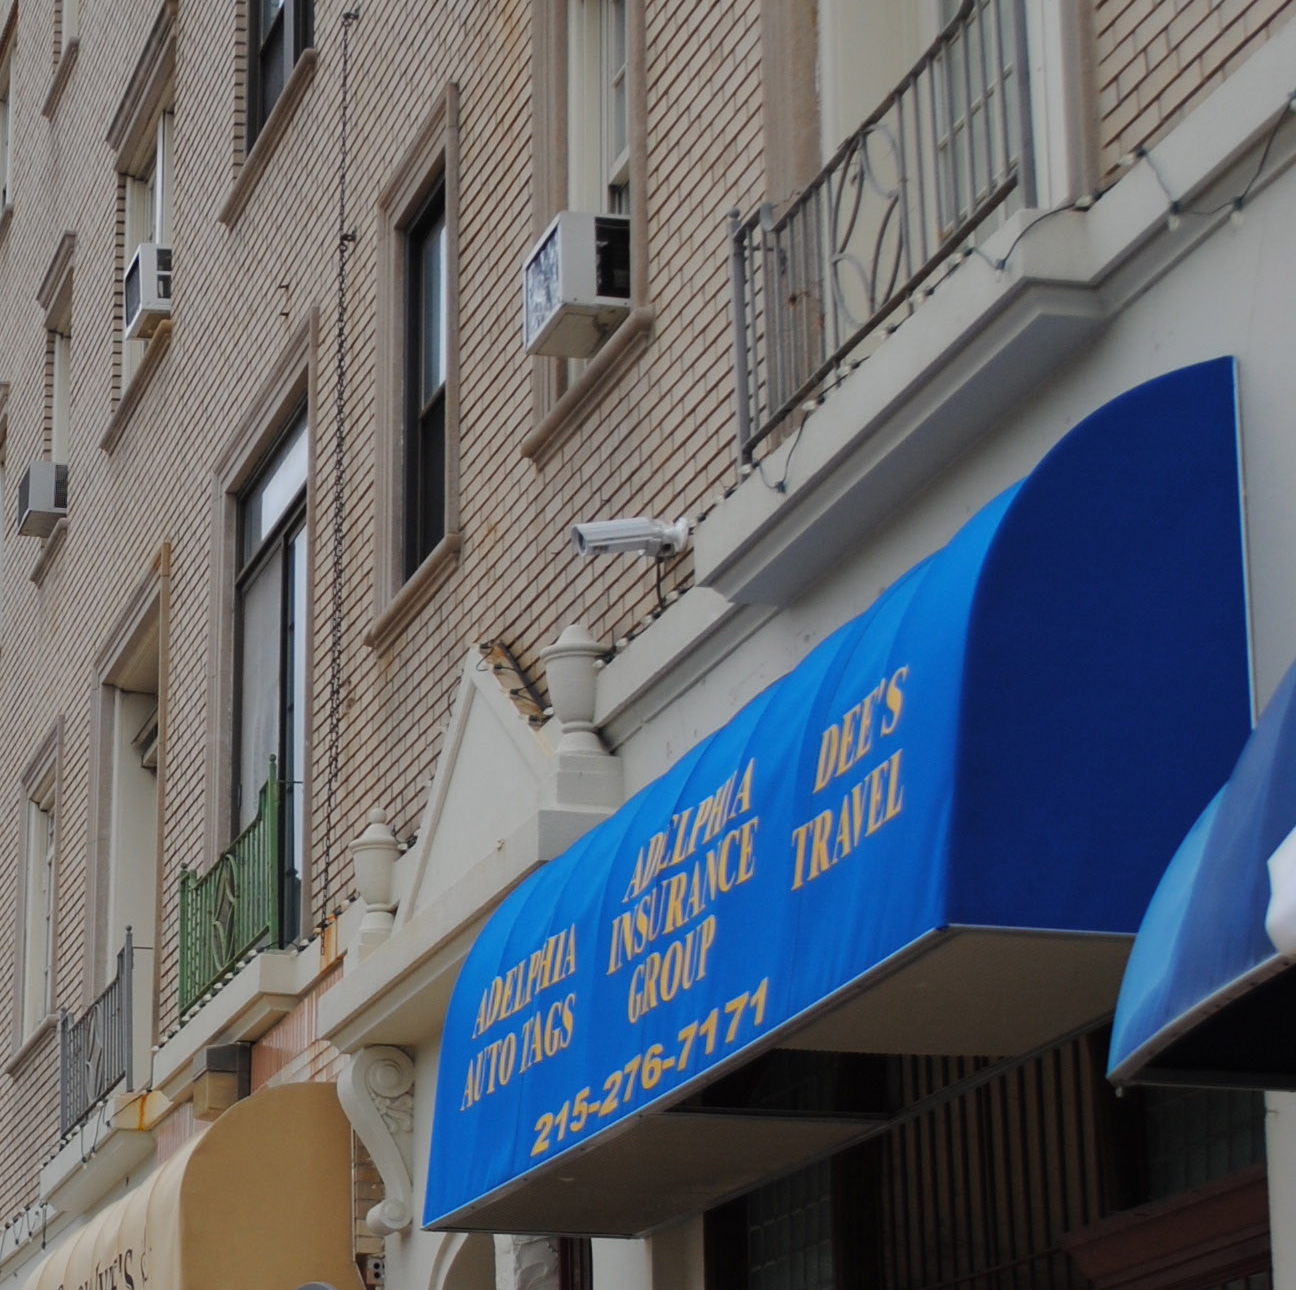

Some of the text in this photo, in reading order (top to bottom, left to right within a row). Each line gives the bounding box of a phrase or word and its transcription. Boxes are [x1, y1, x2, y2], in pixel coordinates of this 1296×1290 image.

[812, 664, 909, 794] DEE'S
[622, 757, 755, 903] ADELPHIA
[790, 748, 903, 891] TRAVEL
[606, 817, 759, 975] INSURANCE
[473, 923, 577, 1039] ADELPHIA
[628, 915, 716, 1024] GROUP
[461, 993, 577, 1111] AUTO TAGS
[530, 976, 769, 1157] 215-276-7171
